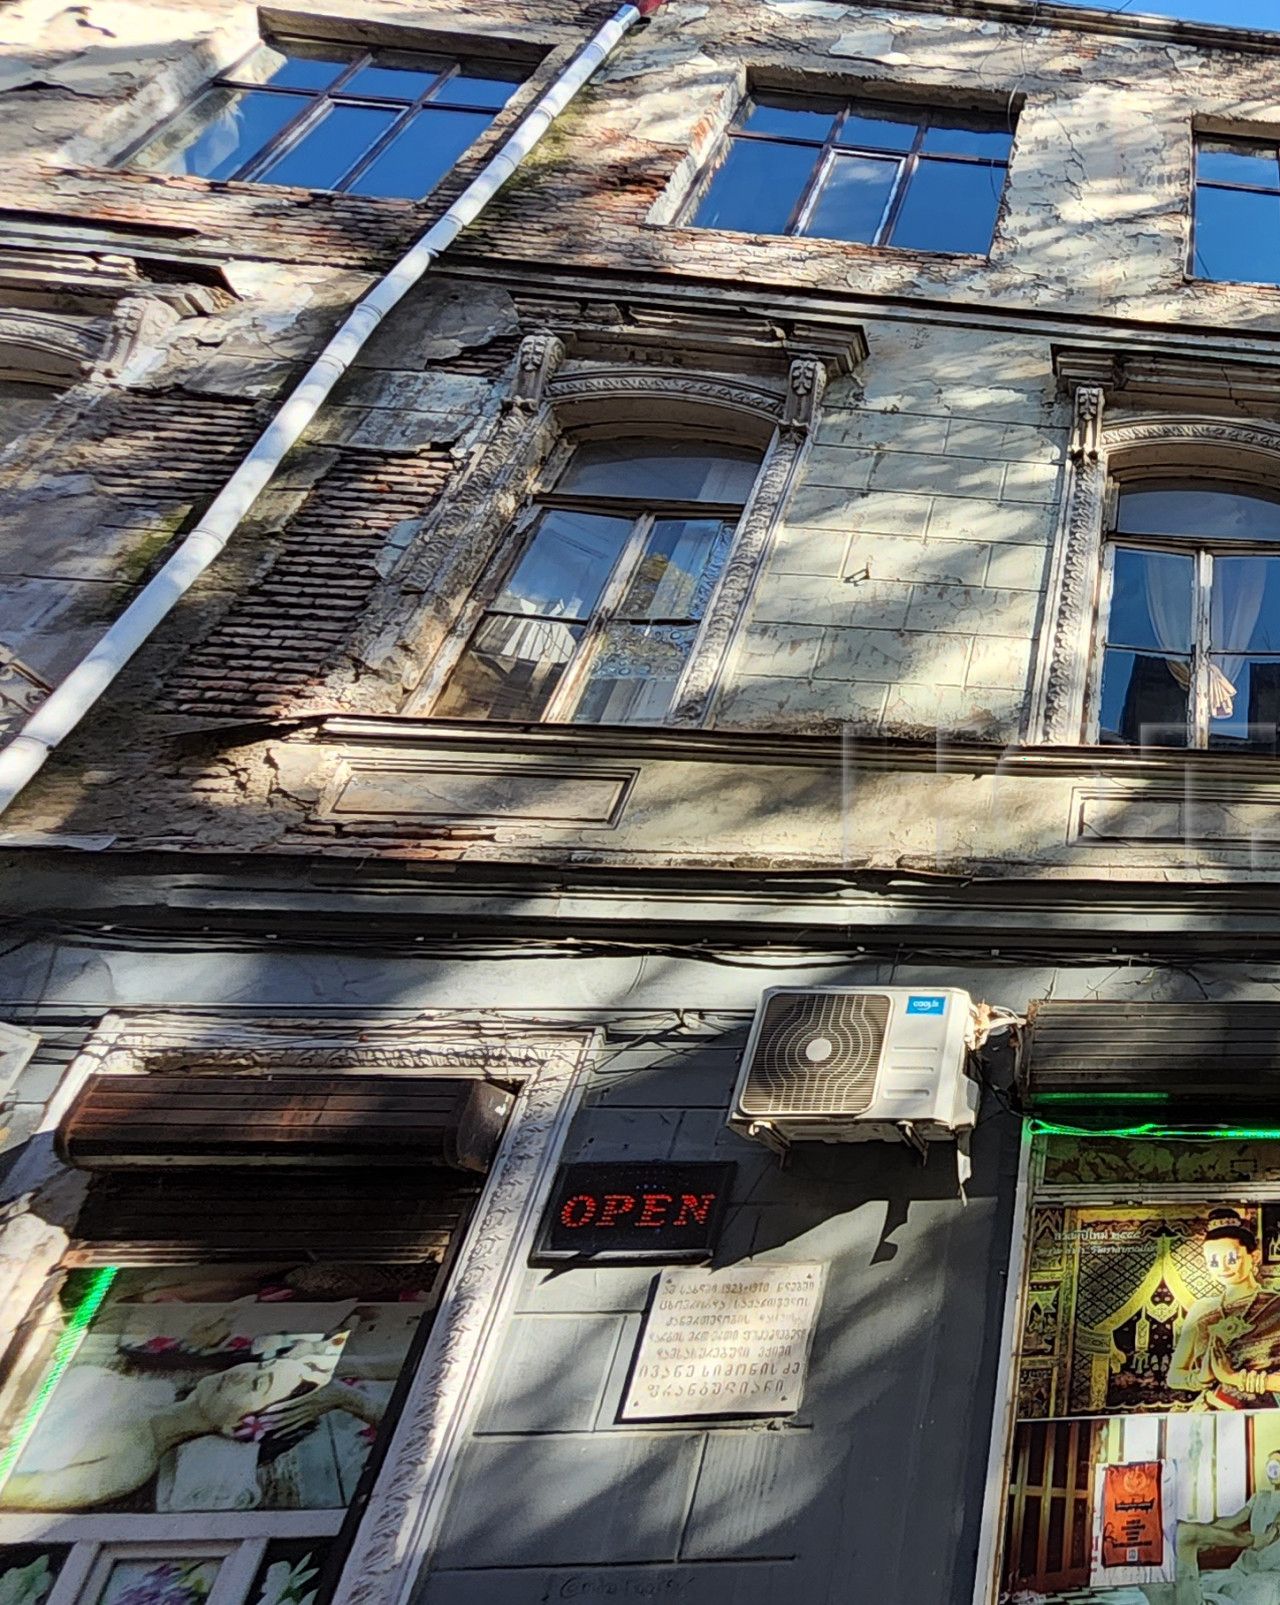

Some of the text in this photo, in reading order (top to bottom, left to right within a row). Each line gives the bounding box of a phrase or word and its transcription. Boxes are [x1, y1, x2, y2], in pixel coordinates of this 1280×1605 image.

[560, 1194, 716, 1227] OPEN
[638, 1361, 801, 1379] ივანე სიმონის ძე
